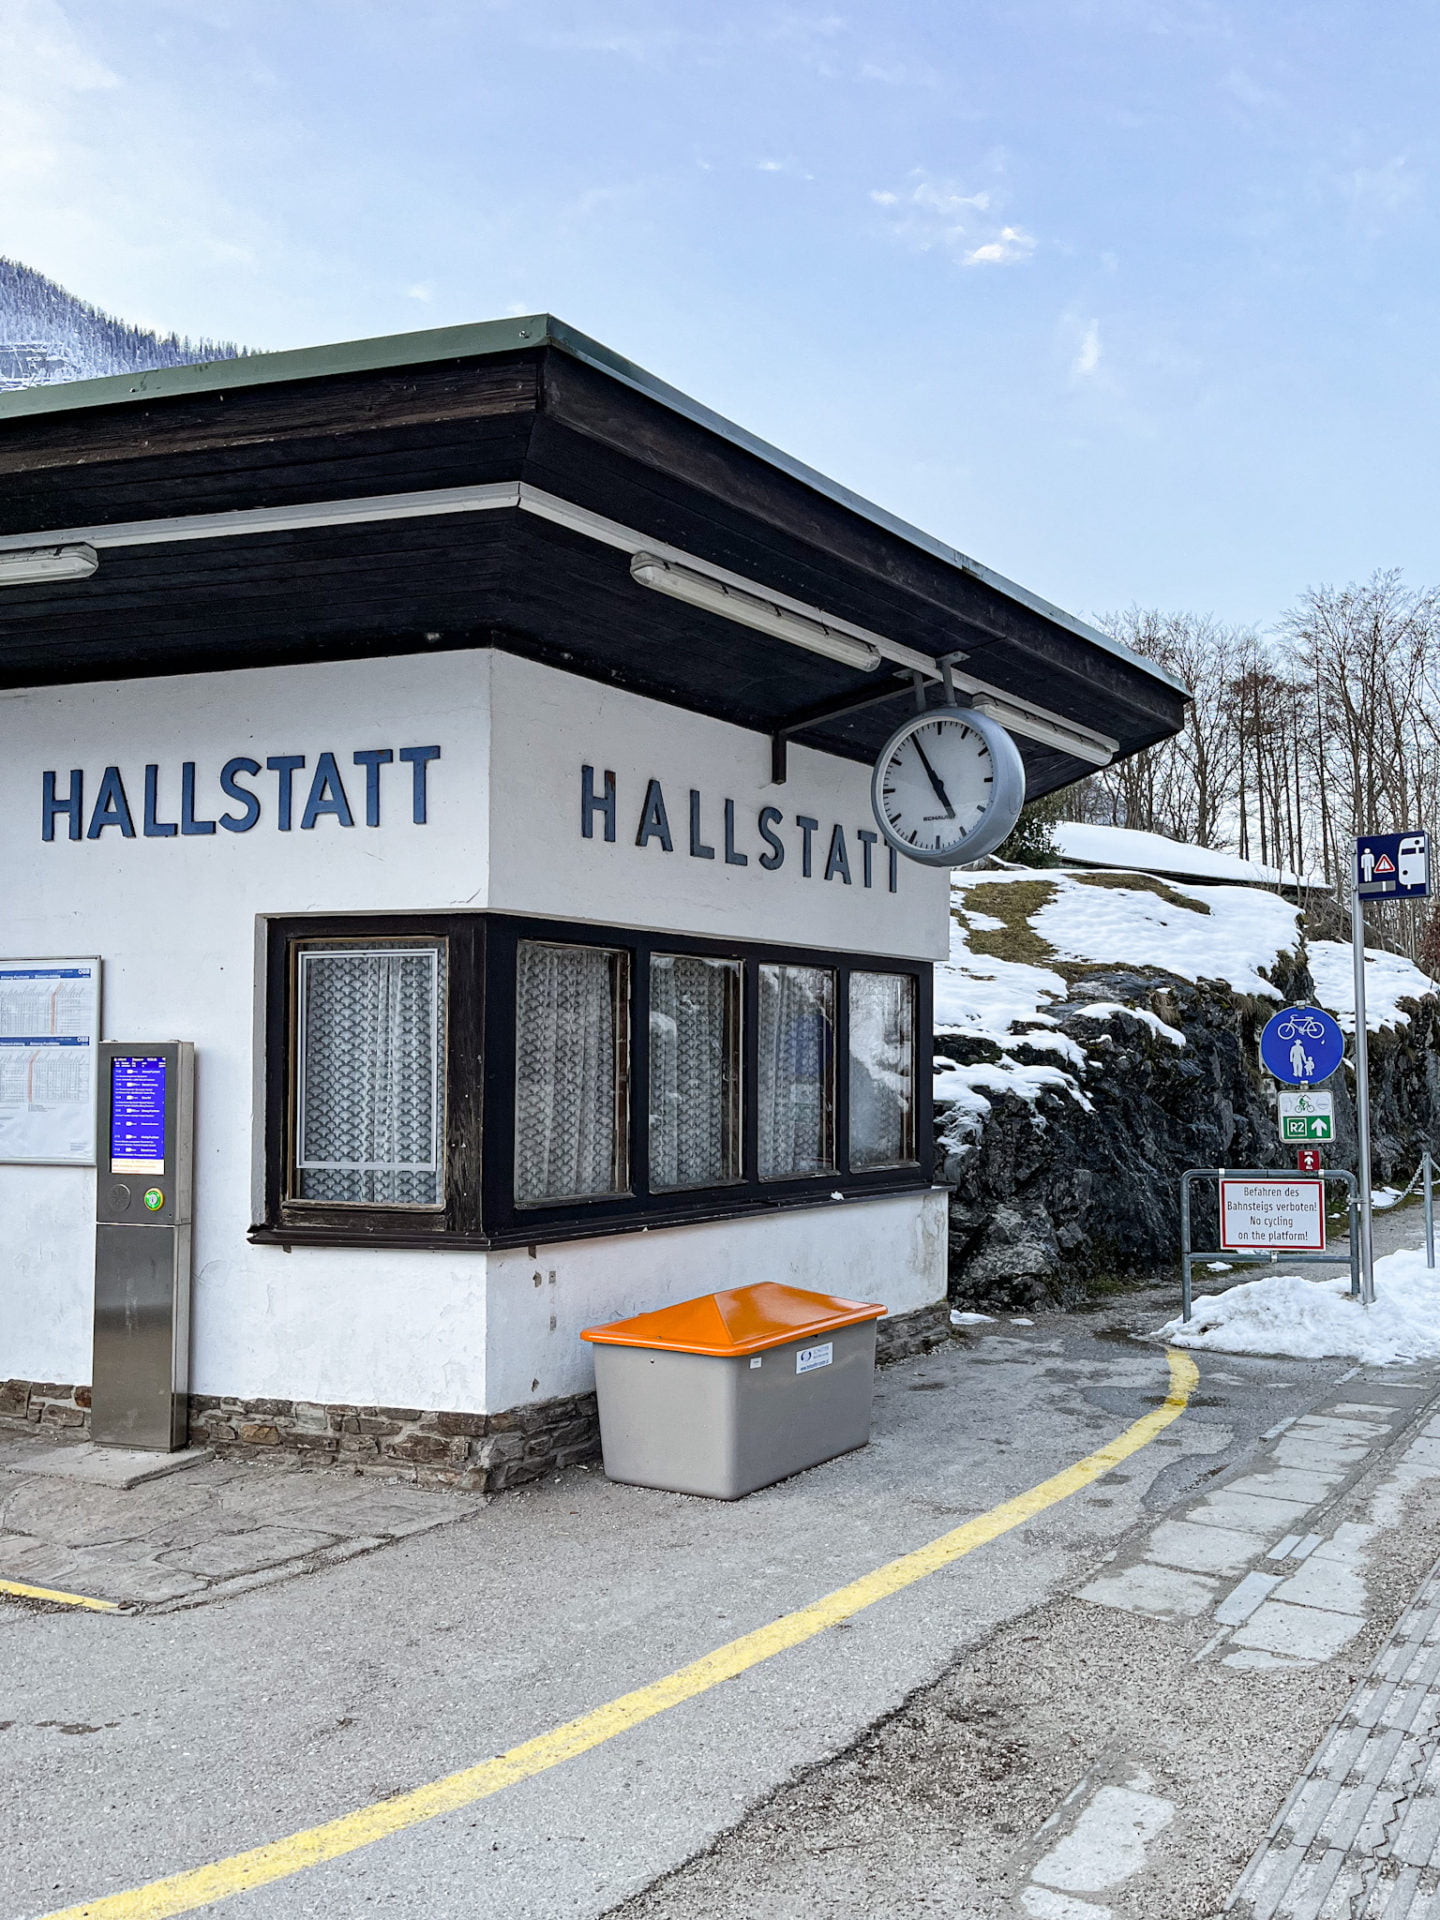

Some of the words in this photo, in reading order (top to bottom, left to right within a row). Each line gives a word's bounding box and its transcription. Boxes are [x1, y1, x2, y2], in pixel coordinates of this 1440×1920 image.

[41, 745, 441, 841] HALLSTATT
[1290, 1122, 1305, 1133] R2
[1243, 1186, 1282, 1197] Befahren
[1284, 1187, 1300, 1197] des
[1227, 1201, 1273, 1213] Bahnsteigs
[1276, 1202, 1317, 1212] verboten!
[1250, 1216, 1261, 1226] No
[1264, 1216, 1294, 1228] cycling
[1238, 1232, 1249, 1241] on
[1251, 1231, 1266, 1241] the
[1268, 1231, 1309, 1243] platform!
